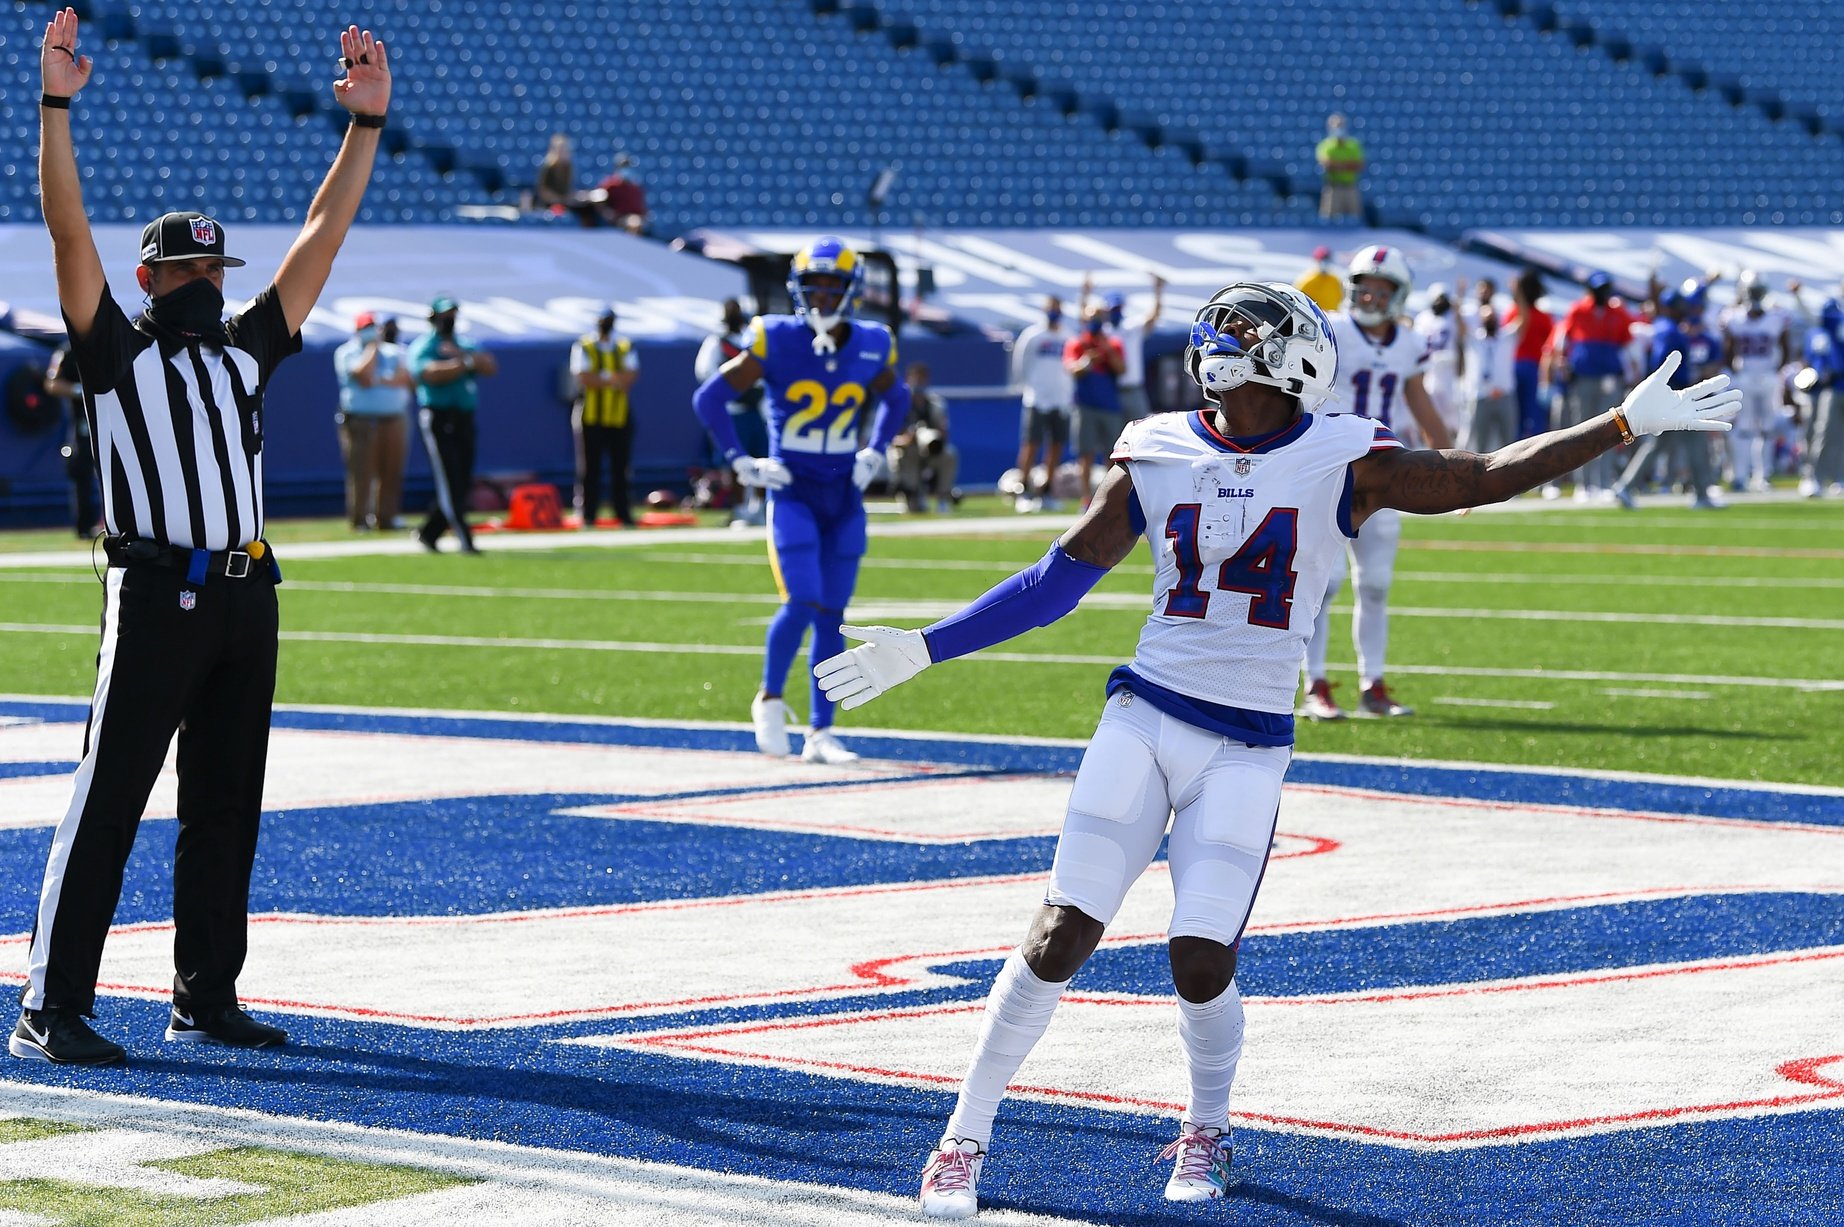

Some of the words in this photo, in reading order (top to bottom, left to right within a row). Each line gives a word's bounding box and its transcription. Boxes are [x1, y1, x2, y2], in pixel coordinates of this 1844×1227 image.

[781, 379, 864, 454] 22
[1351, 370, 1397, 429] 11
[1217, 488, 1254, 498] BILLS
[1164, 503, 1299, 630] 14
